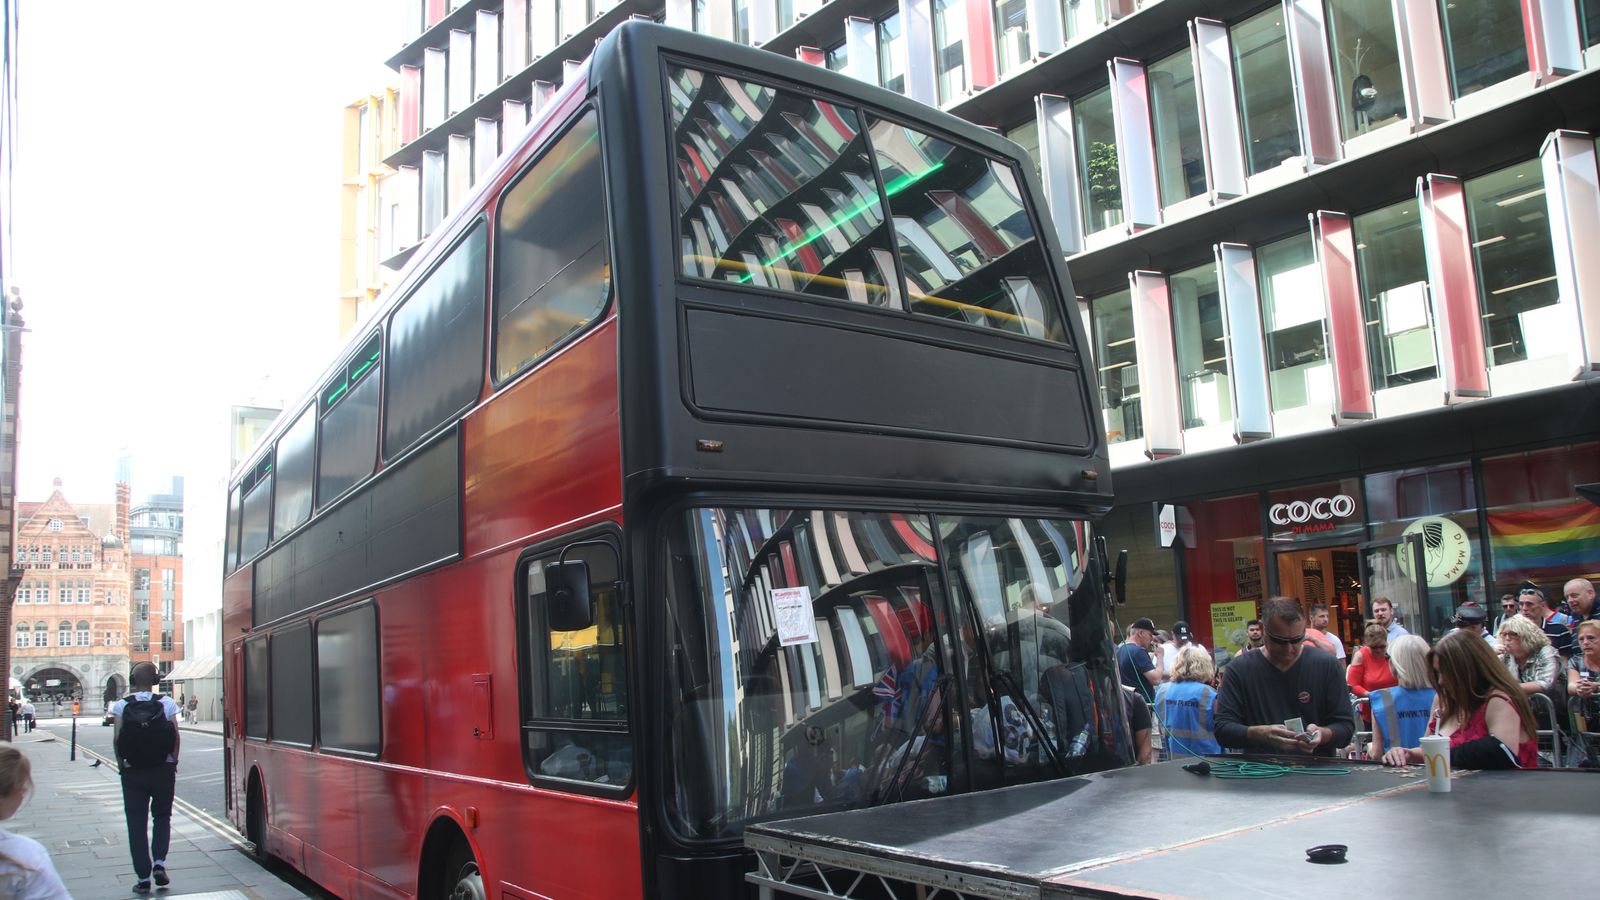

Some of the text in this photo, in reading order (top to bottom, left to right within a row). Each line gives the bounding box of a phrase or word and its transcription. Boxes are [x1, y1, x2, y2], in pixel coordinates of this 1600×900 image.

[1269, 495, 1355, 525] COCO
[1161, 521, 1174, 530] COCO
[1304, 522, 1336, 534] MAMA
[1444, 533, 1465, 579] DI MAMA
